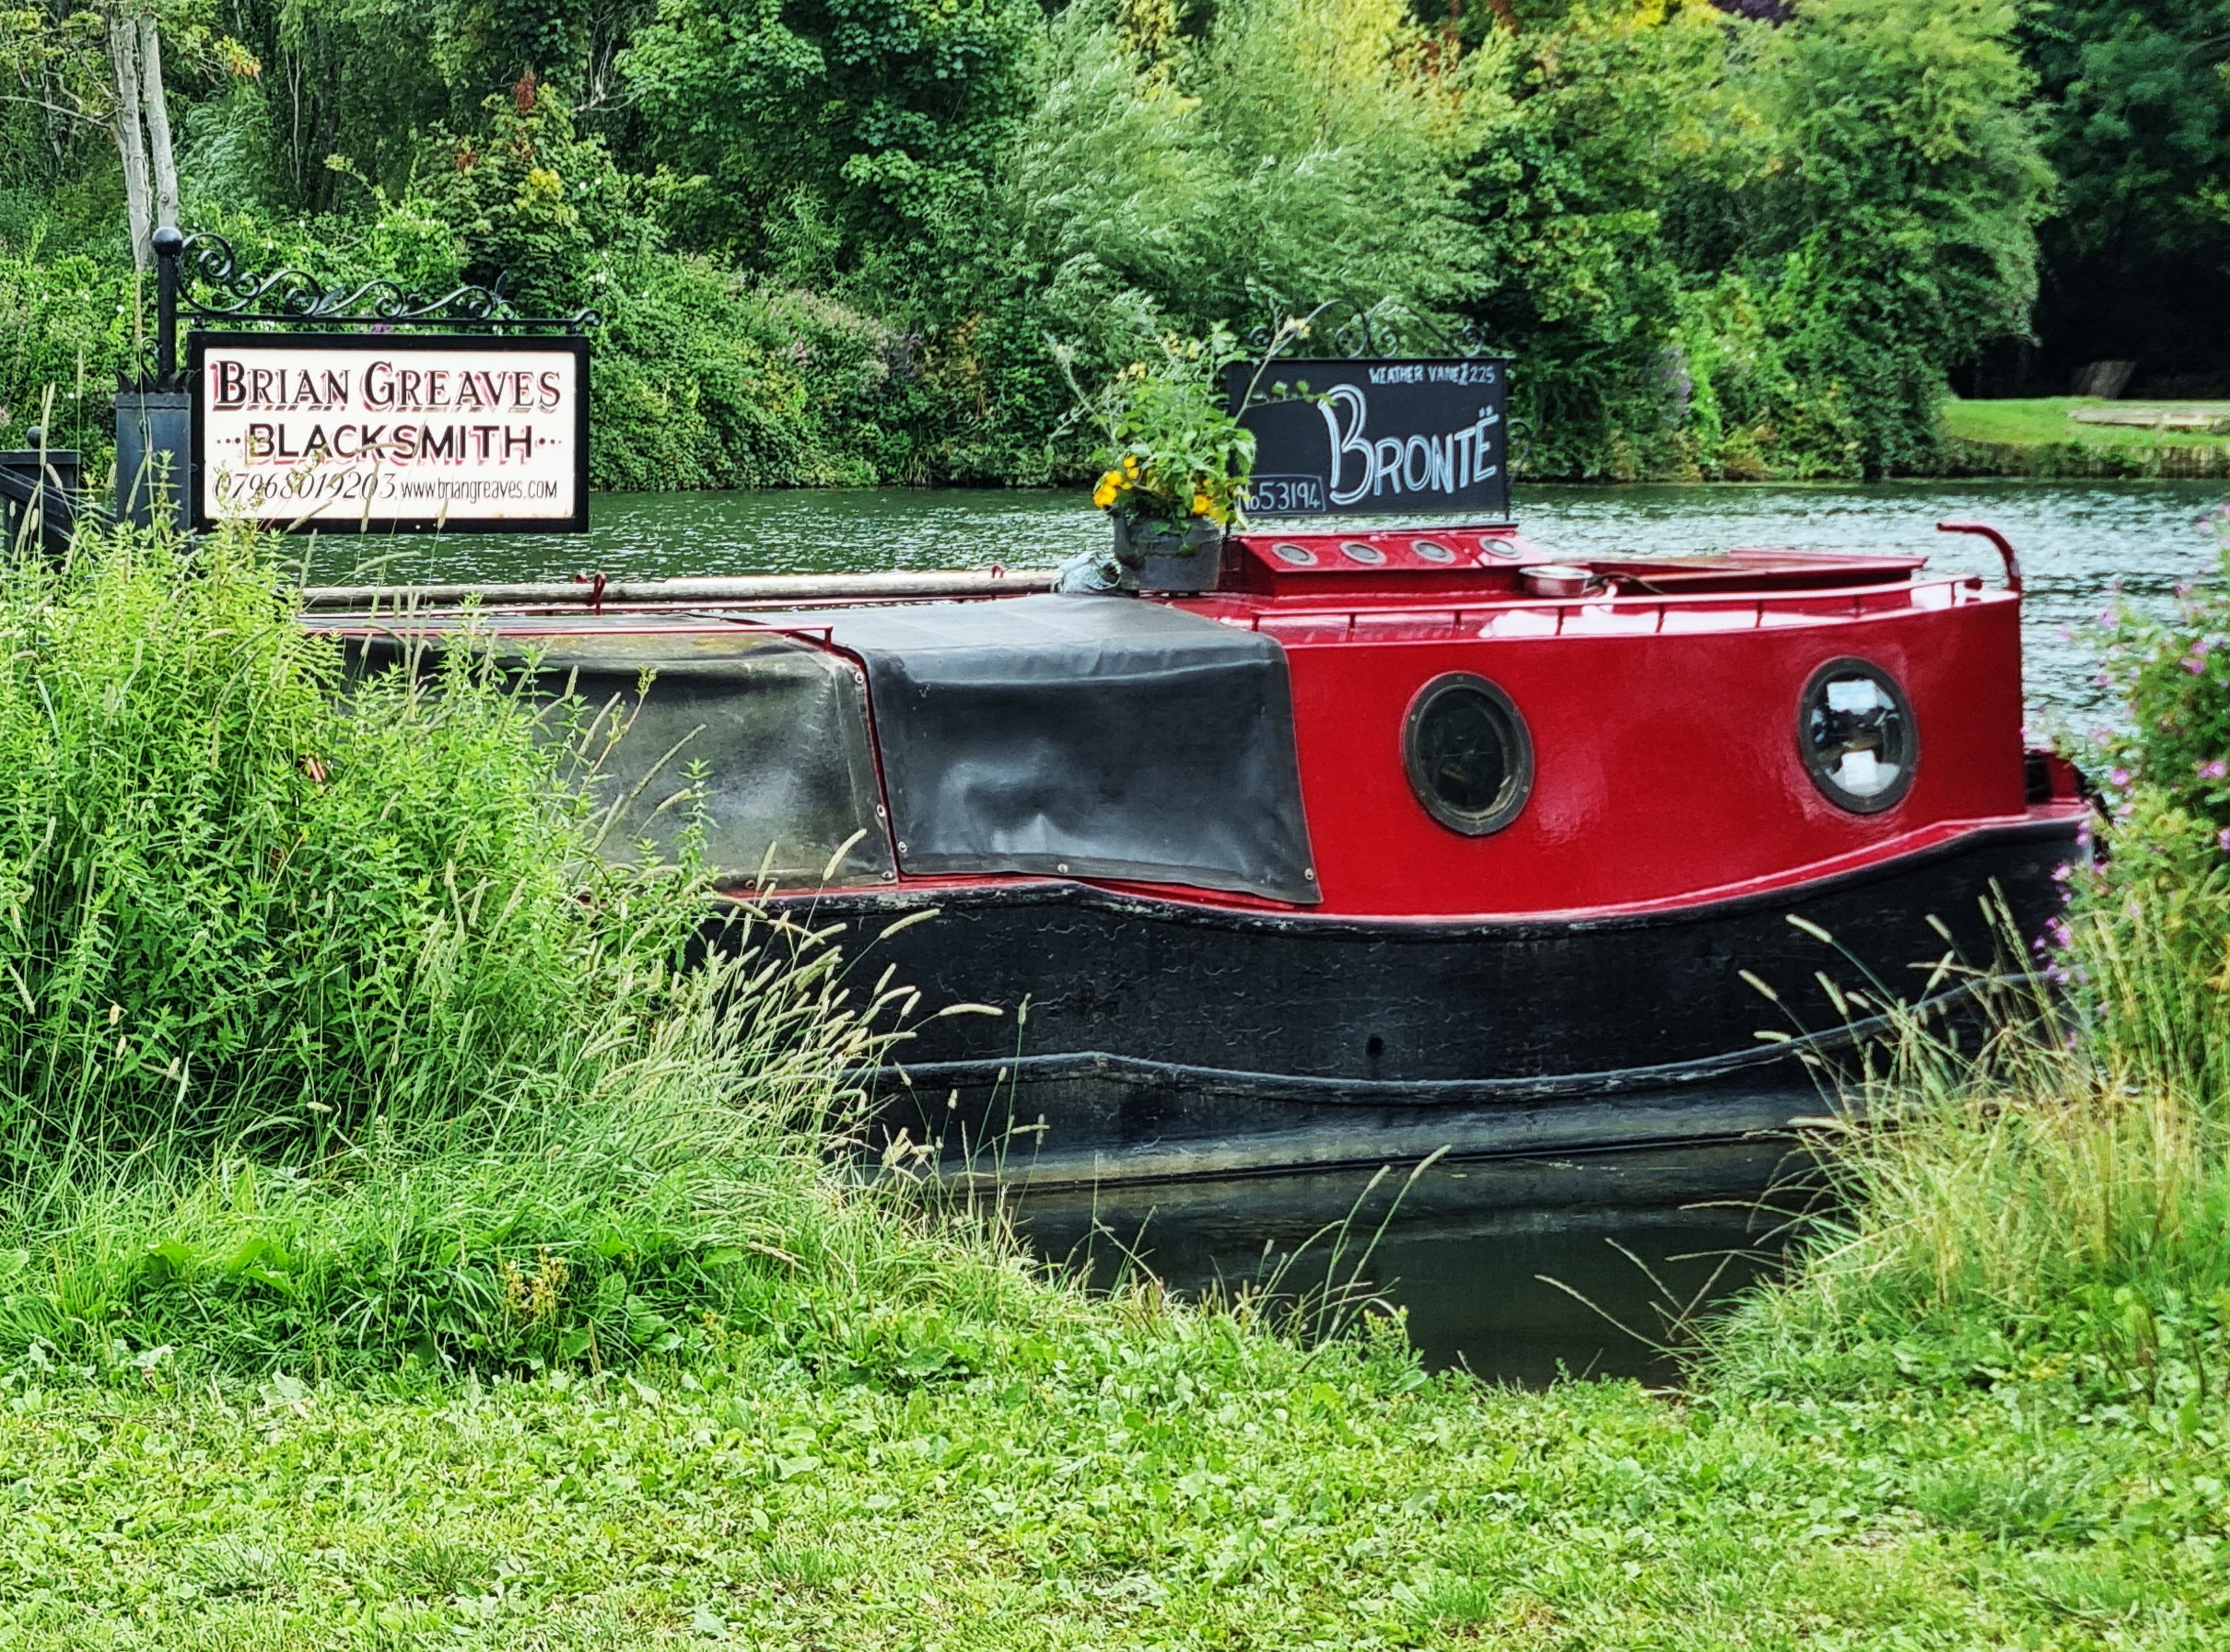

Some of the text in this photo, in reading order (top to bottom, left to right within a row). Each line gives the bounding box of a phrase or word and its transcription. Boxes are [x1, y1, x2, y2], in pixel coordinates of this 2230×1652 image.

[213, 359, 561, 413] BRIAN GREAVES
[1368, 364, 1424, 384] WEATHER
[246, 422, 533, 465] BLACKSMITH
